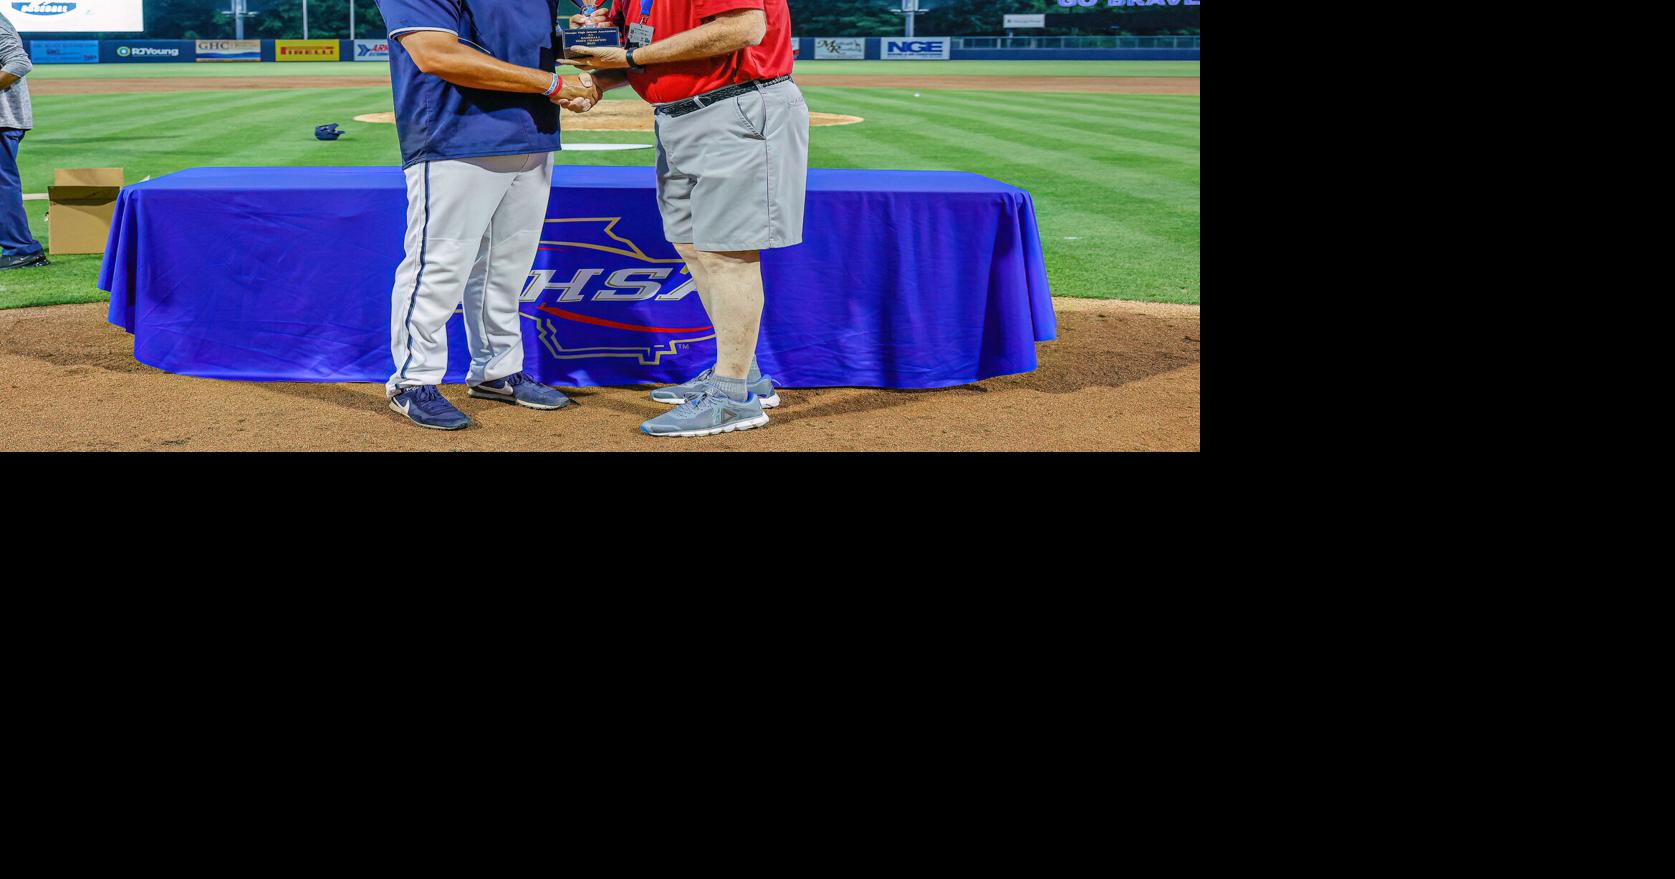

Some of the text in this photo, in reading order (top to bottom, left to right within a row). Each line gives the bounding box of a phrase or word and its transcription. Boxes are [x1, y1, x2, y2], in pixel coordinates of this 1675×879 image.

[198, 42, 229, 50] GHC
[888, 41, 943, 53] NGE
[131, 47, 179, 56] RJYoung
